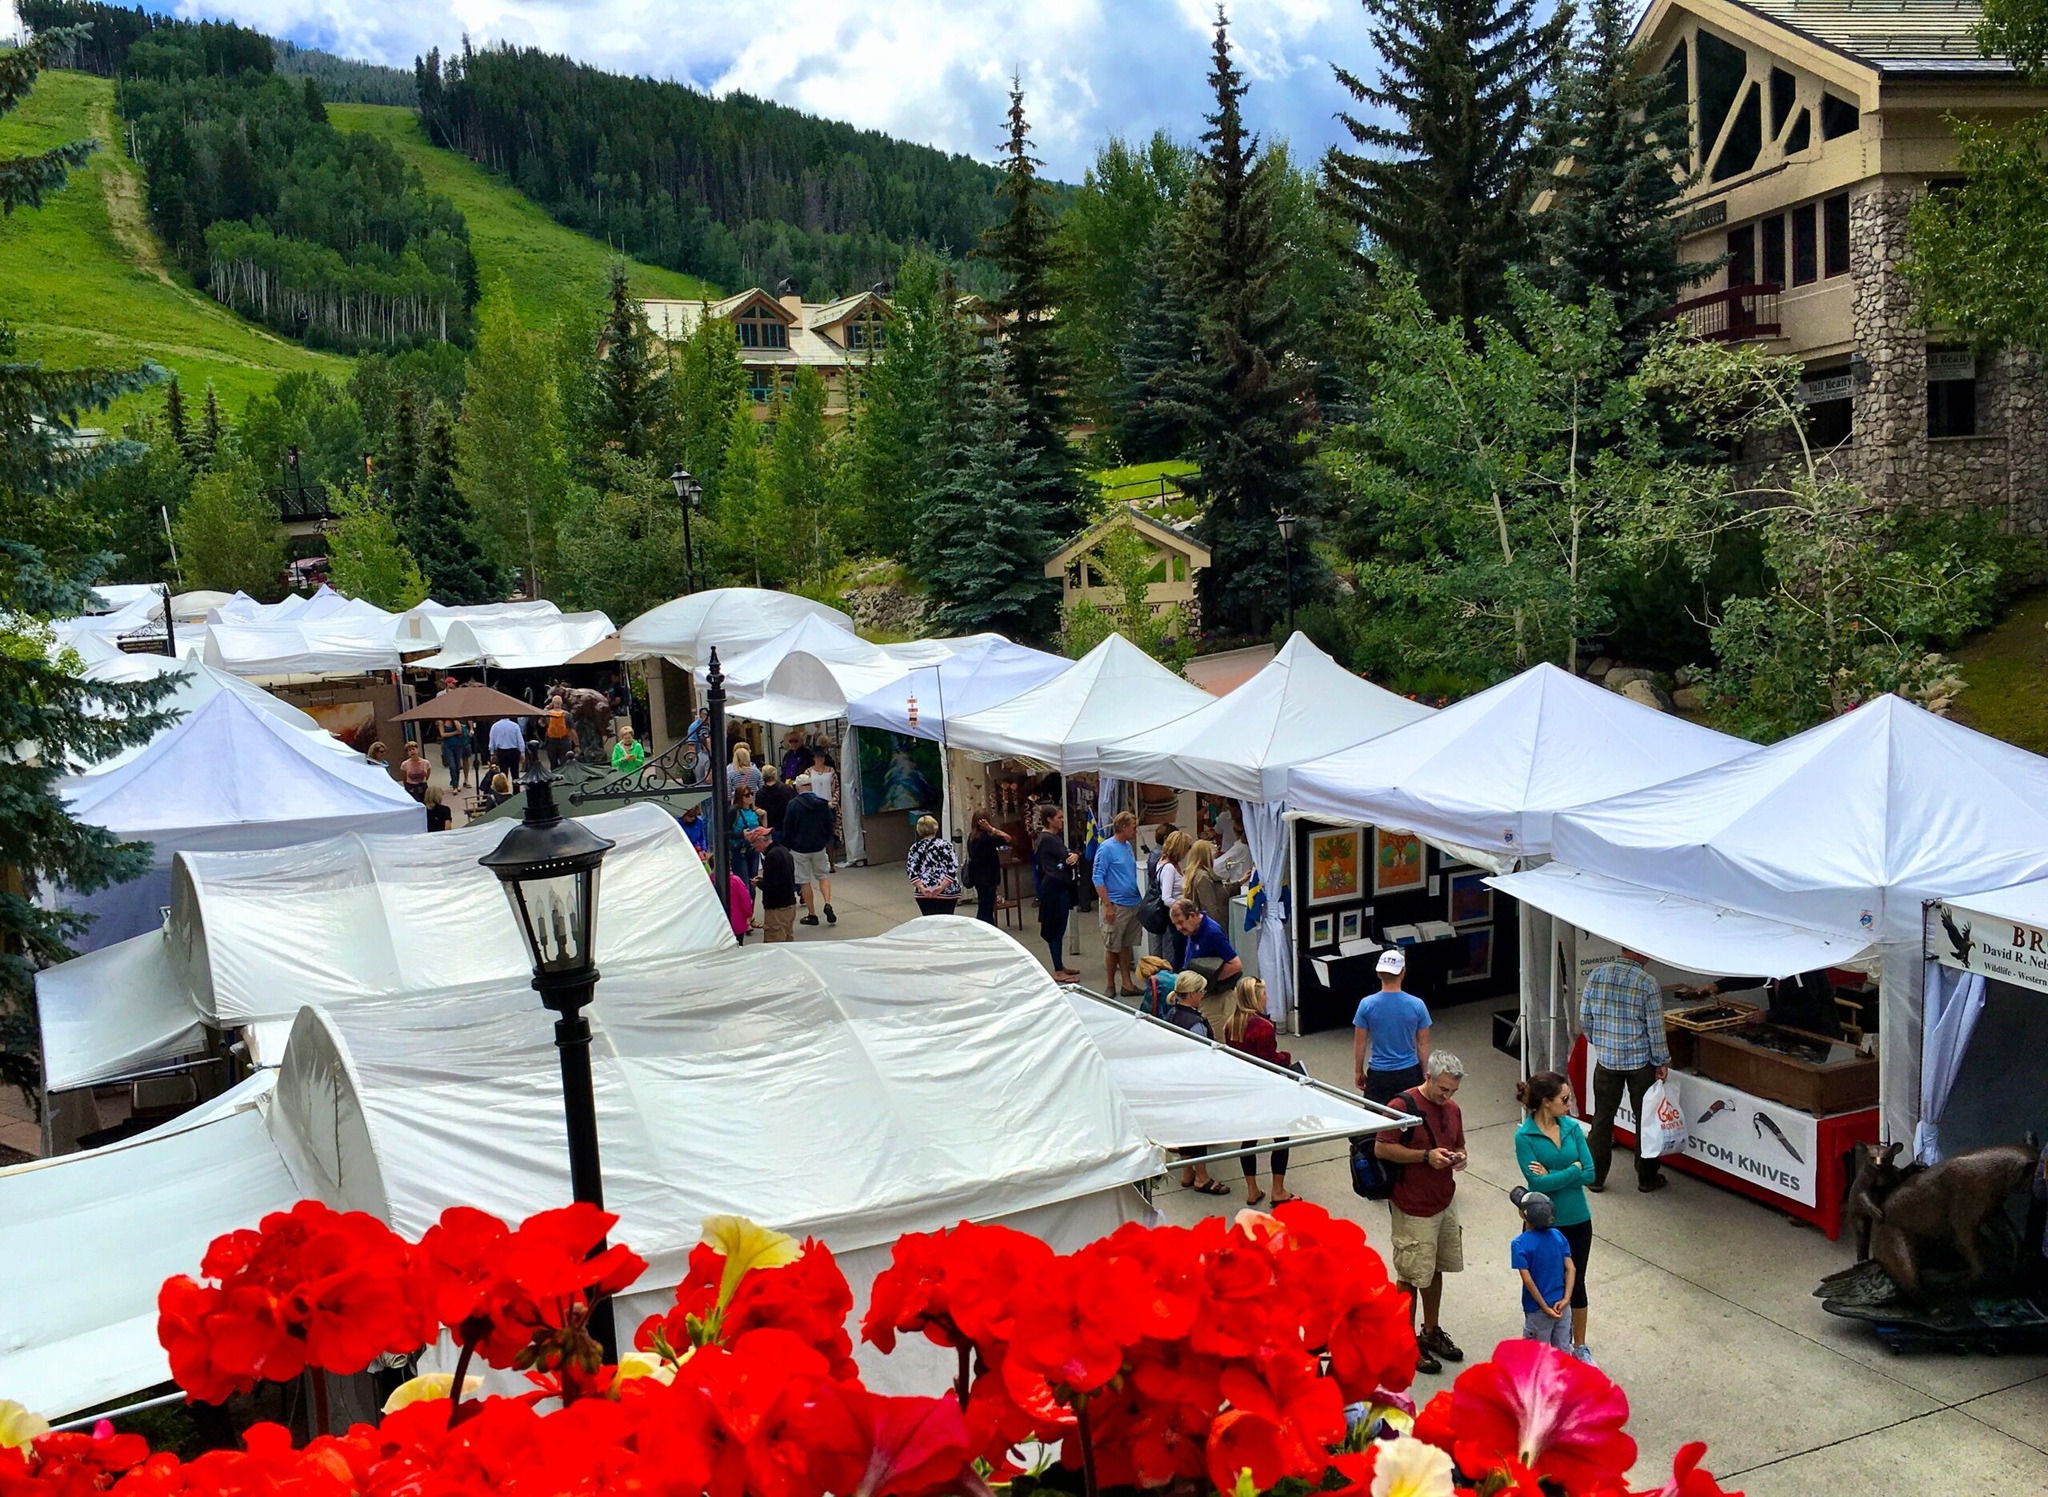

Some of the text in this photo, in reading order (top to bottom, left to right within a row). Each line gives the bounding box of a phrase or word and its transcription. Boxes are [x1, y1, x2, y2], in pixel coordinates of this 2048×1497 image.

[1808, 377, 1852, 392] Vail Realty
[1097, 604, 1161, 616] STRARY
[2012, 925, 2048, 954] BR
[1581, 956, 1616, 966] DAMASCUS
[1983, 943, 2012, 960] David
[2015, 951, 2027, 964] R.
[1984, 962, 2012, 977] Wildlife
[2018, 971, 2048, 986] Western
[1688, 1135, 1733, 1164] STOM
[1738, 1154, 1800, 1191] KNIVES
